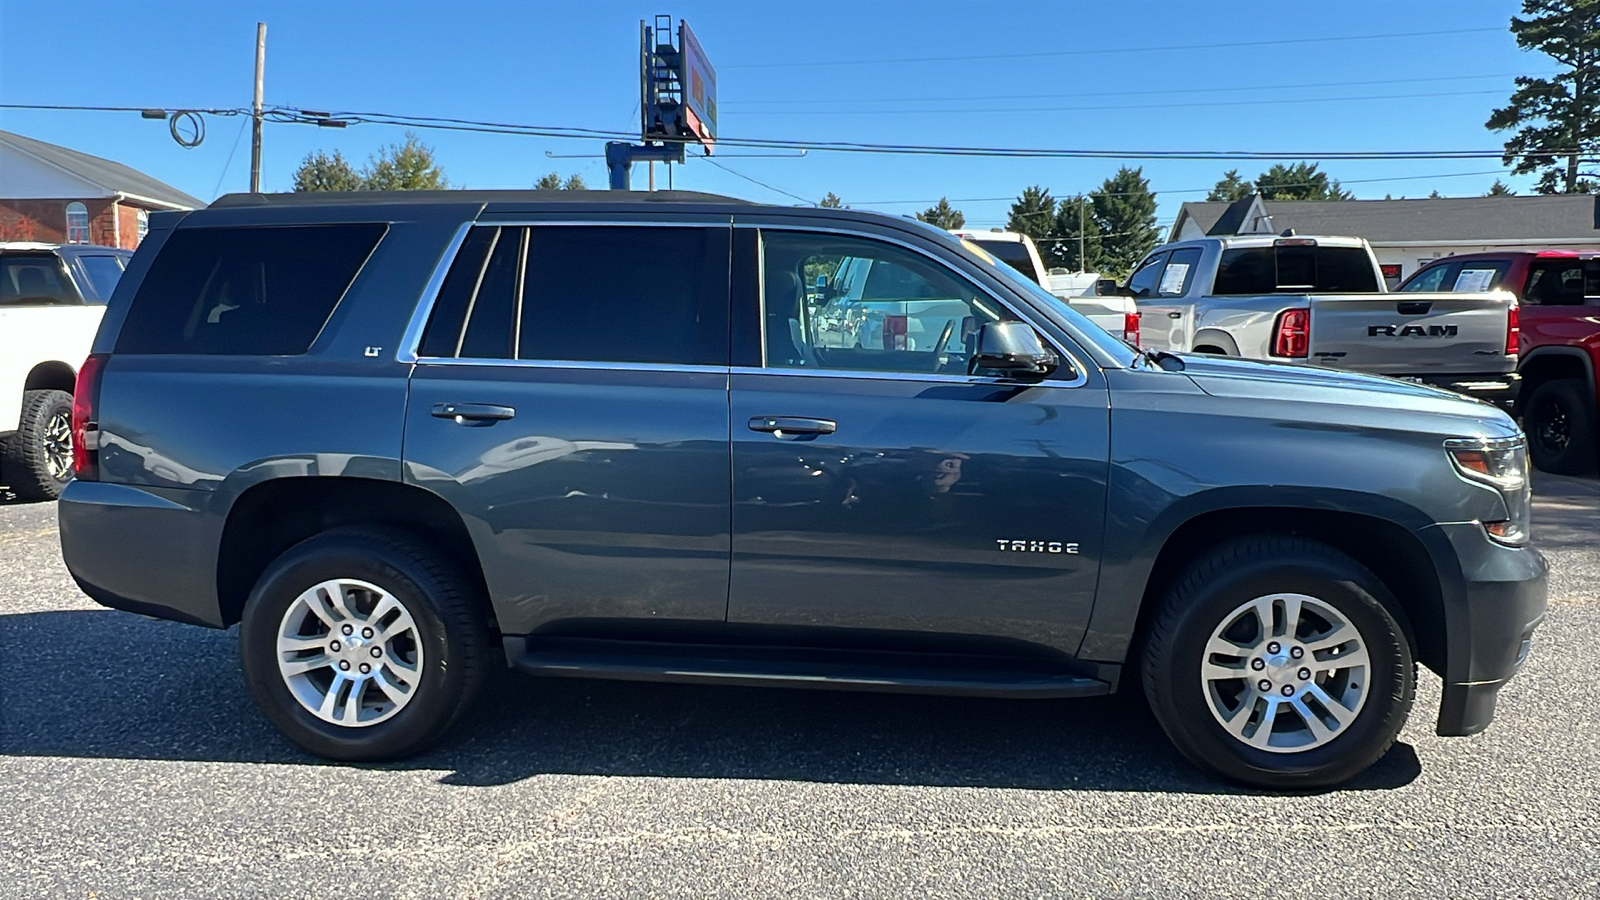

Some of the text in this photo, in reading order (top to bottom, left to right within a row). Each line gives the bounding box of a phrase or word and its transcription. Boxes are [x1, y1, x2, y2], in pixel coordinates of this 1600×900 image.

[1368, 325, 1458, 337] RAM
[365, 346, 382, 356] LT
[997, 539, 1079, 554] TAHOE
